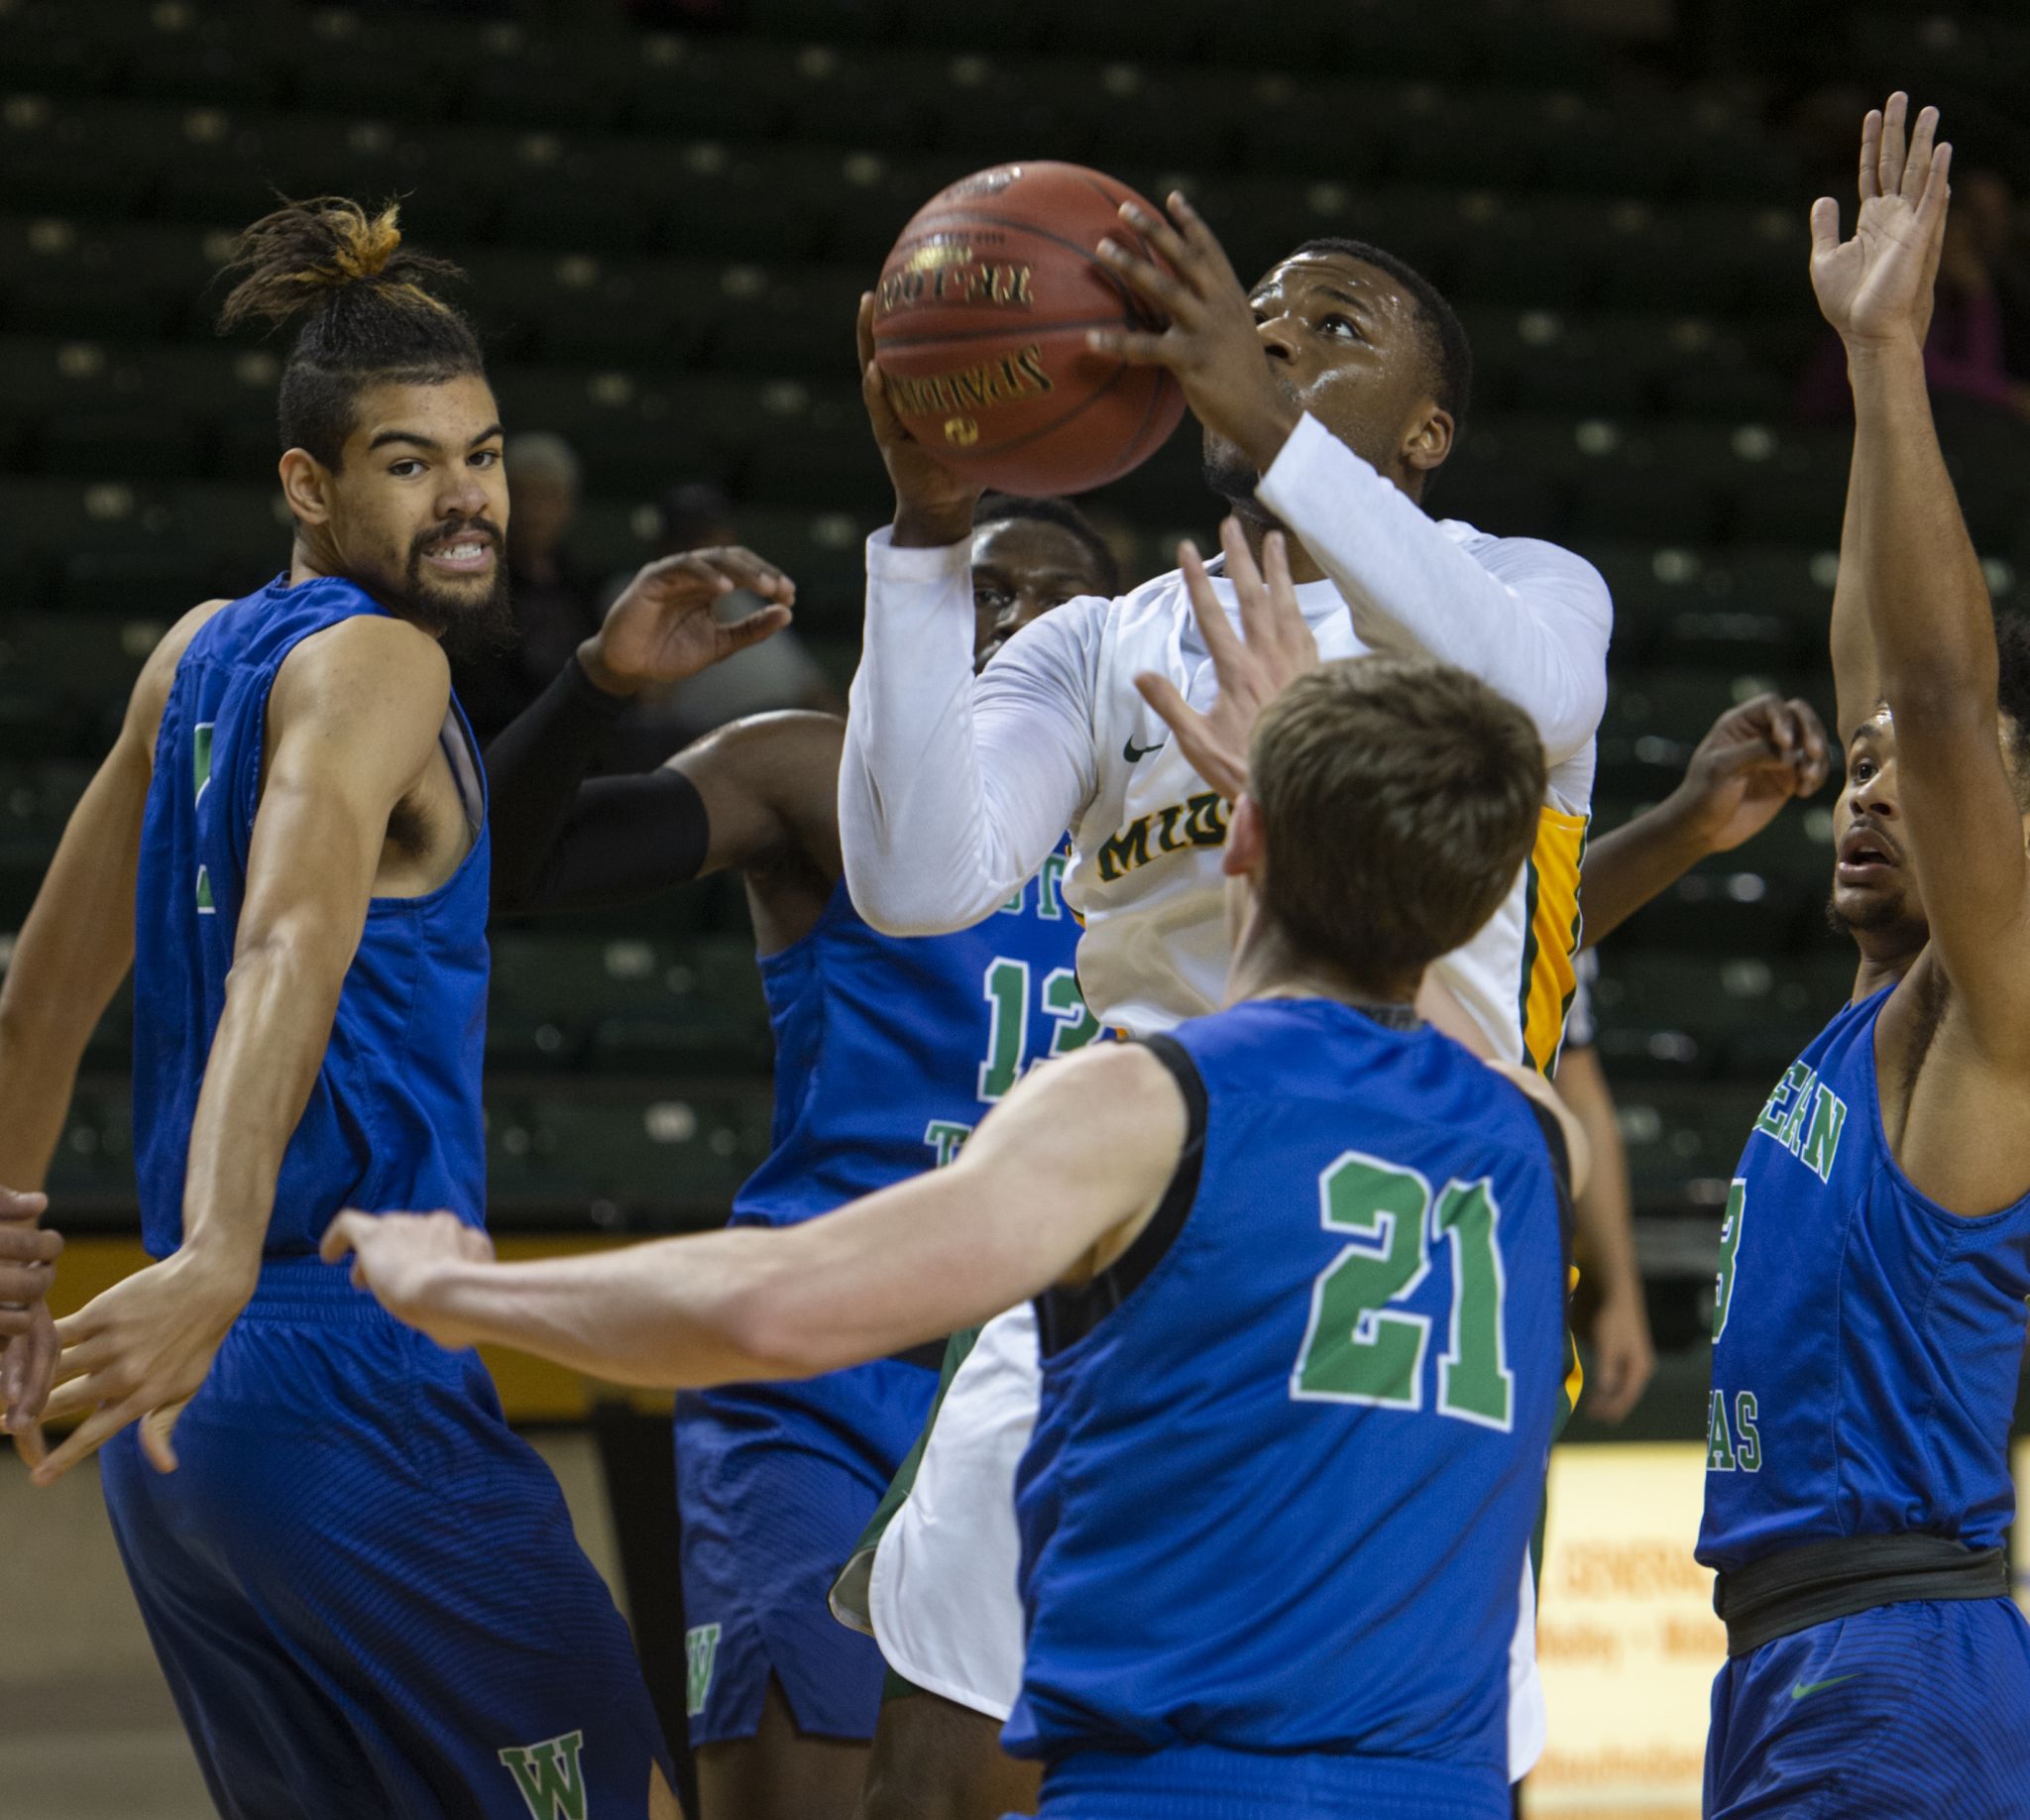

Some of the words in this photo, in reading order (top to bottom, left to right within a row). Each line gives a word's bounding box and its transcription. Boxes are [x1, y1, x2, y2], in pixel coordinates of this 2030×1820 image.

[1289, 1148, 1515, 1433] 21
[685, 1622, 722, 1717] W
[498, 1729, 588, 1820] W
